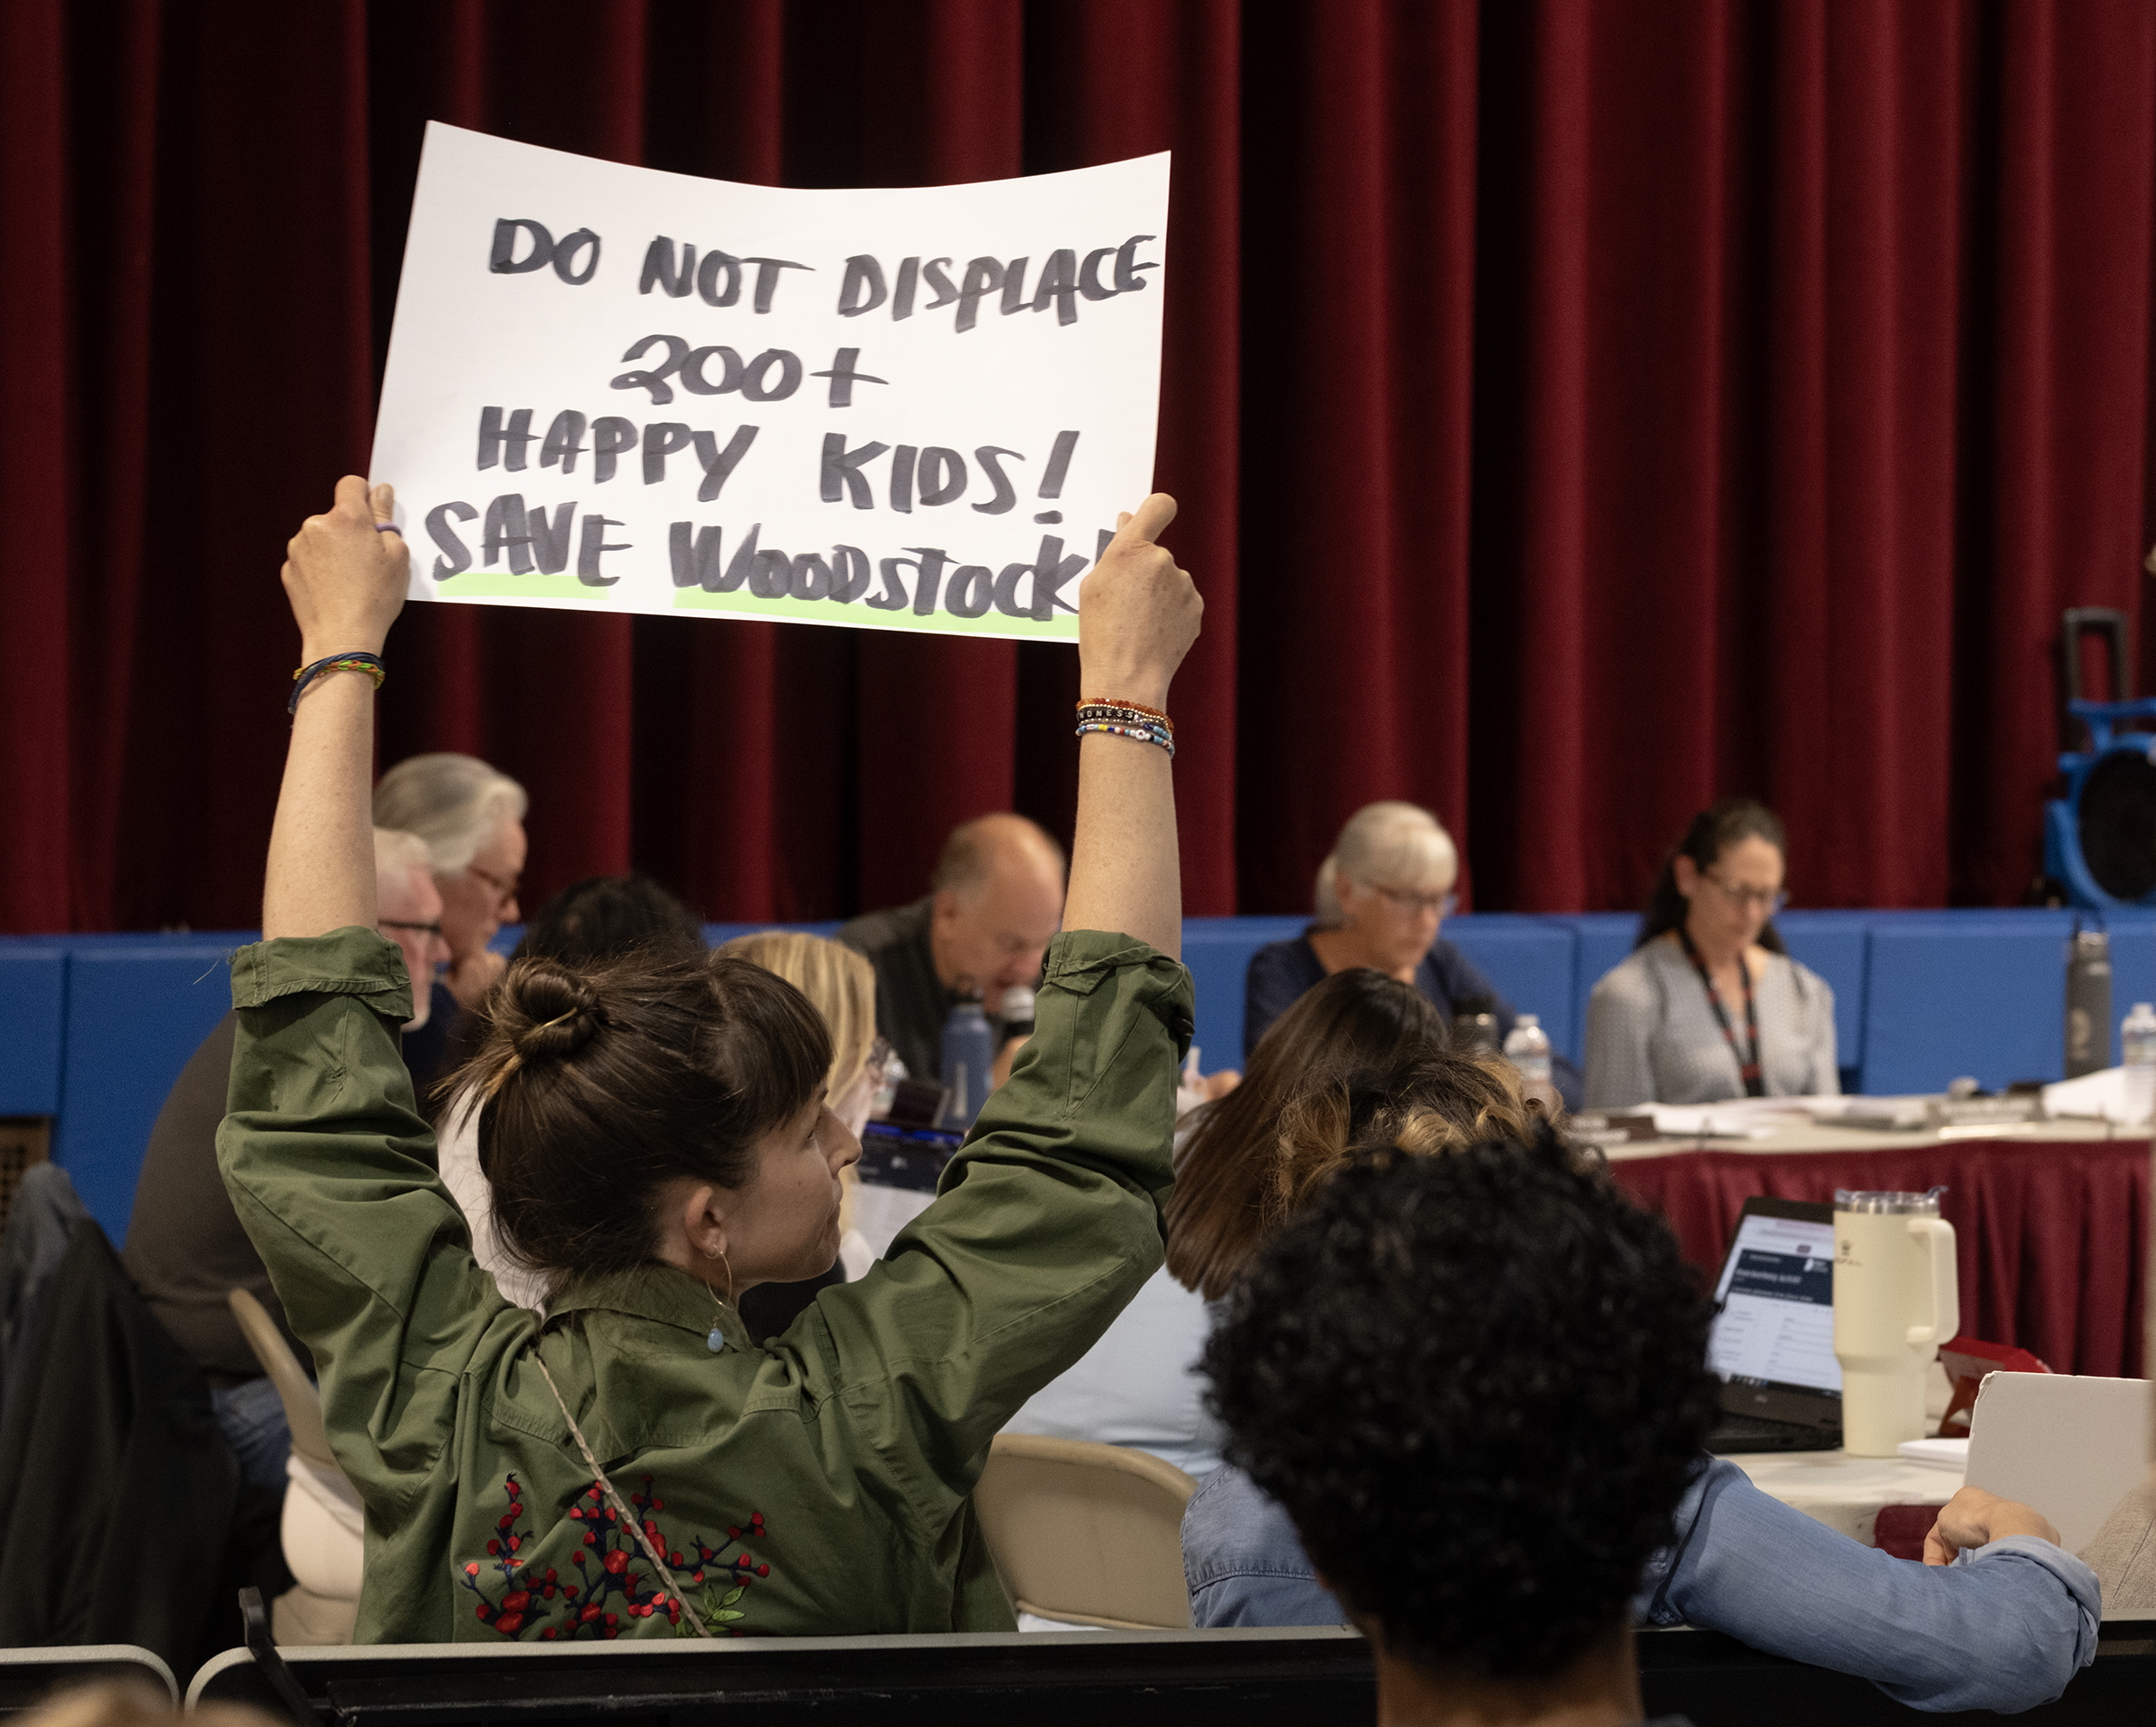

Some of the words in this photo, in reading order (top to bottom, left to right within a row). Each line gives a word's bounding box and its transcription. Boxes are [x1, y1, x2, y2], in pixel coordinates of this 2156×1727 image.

[488, 217, 601, 285] DO
[640, 235, 815, 314] NOT
[838, 235, 1160, 333] DISPLACE
[611, 335, 889, 407] 200+
[476, 406, 760, 501] HAPPY
[820, 430, 1080, 524] KIDS!
[425, 493, 633, 586] SAVE
